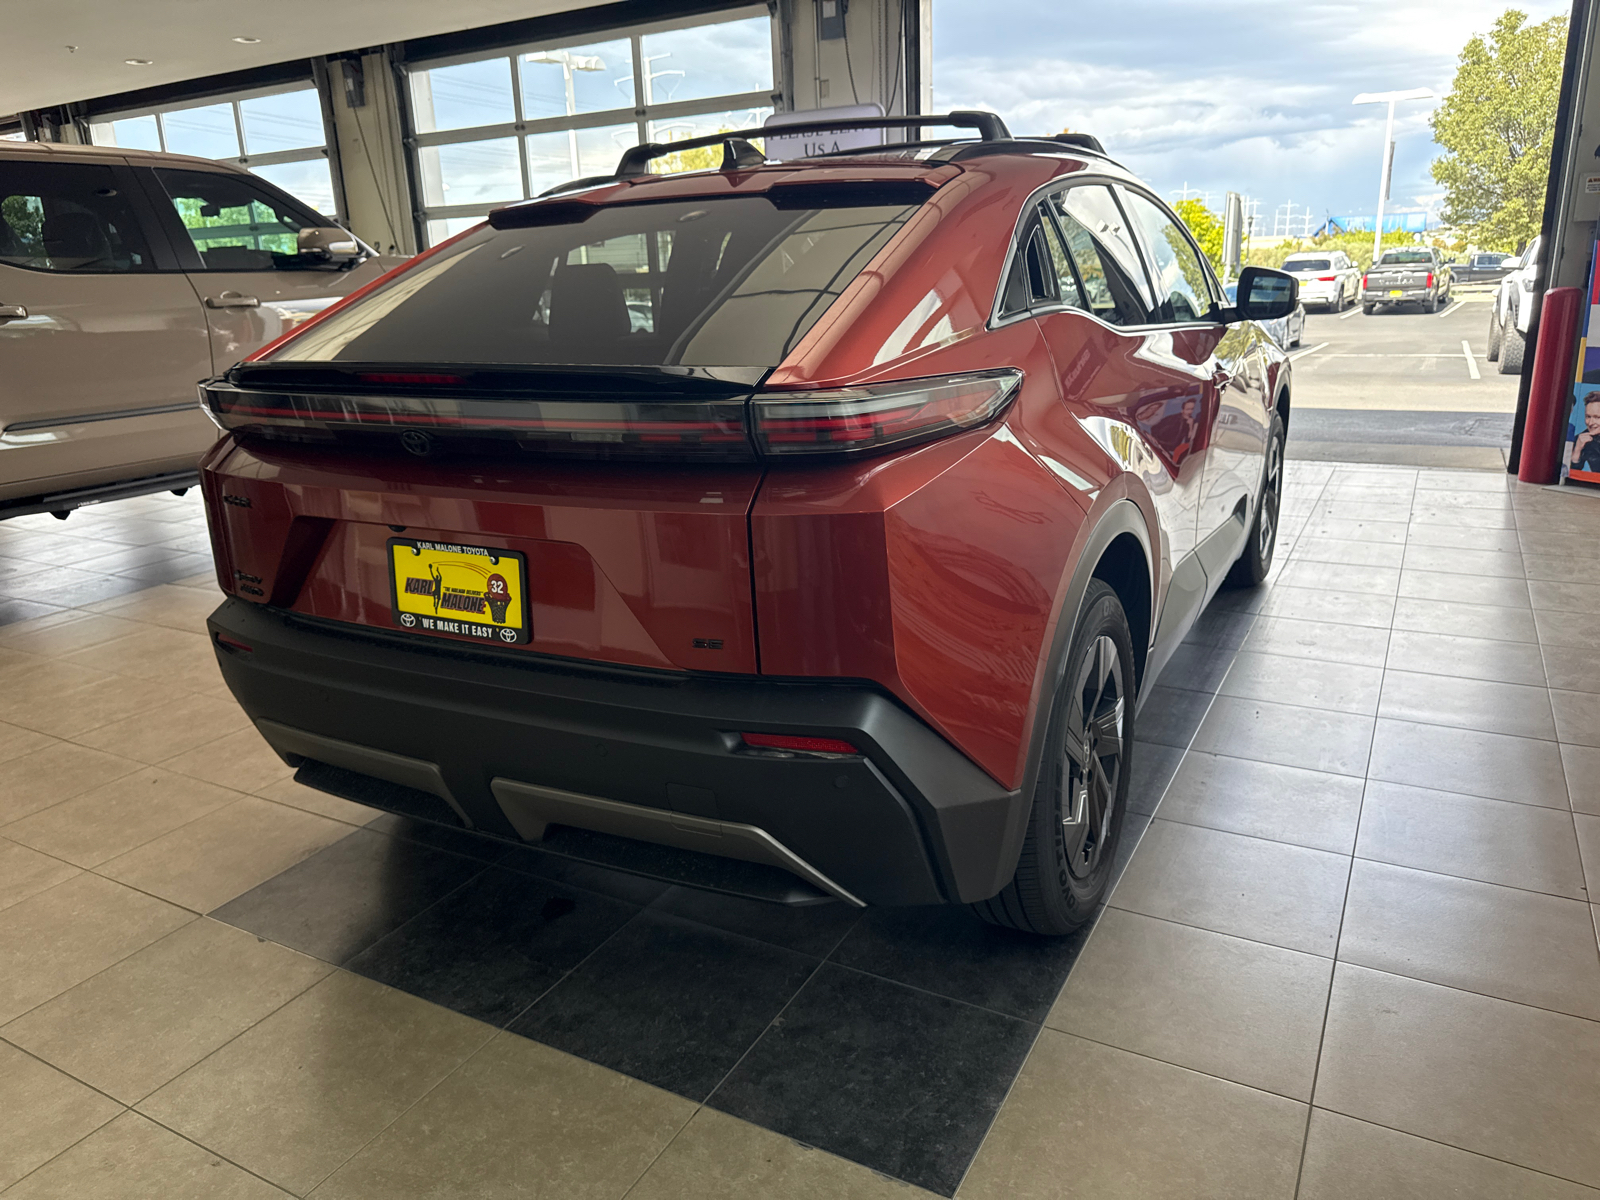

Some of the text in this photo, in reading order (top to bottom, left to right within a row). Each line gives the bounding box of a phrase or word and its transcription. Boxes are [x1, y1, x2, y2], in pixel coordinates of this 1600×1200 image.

[831, 140, 840, 153] A
[416, 541, 489, 556] KARL MALONE TOYOTA
[404, 577, 435, 596] KARL
[490, 580, 504, 594] 32
[440, 592, 486, 614] MALONE
[422, 618, 493, 638] WE MAKE IT EASY
